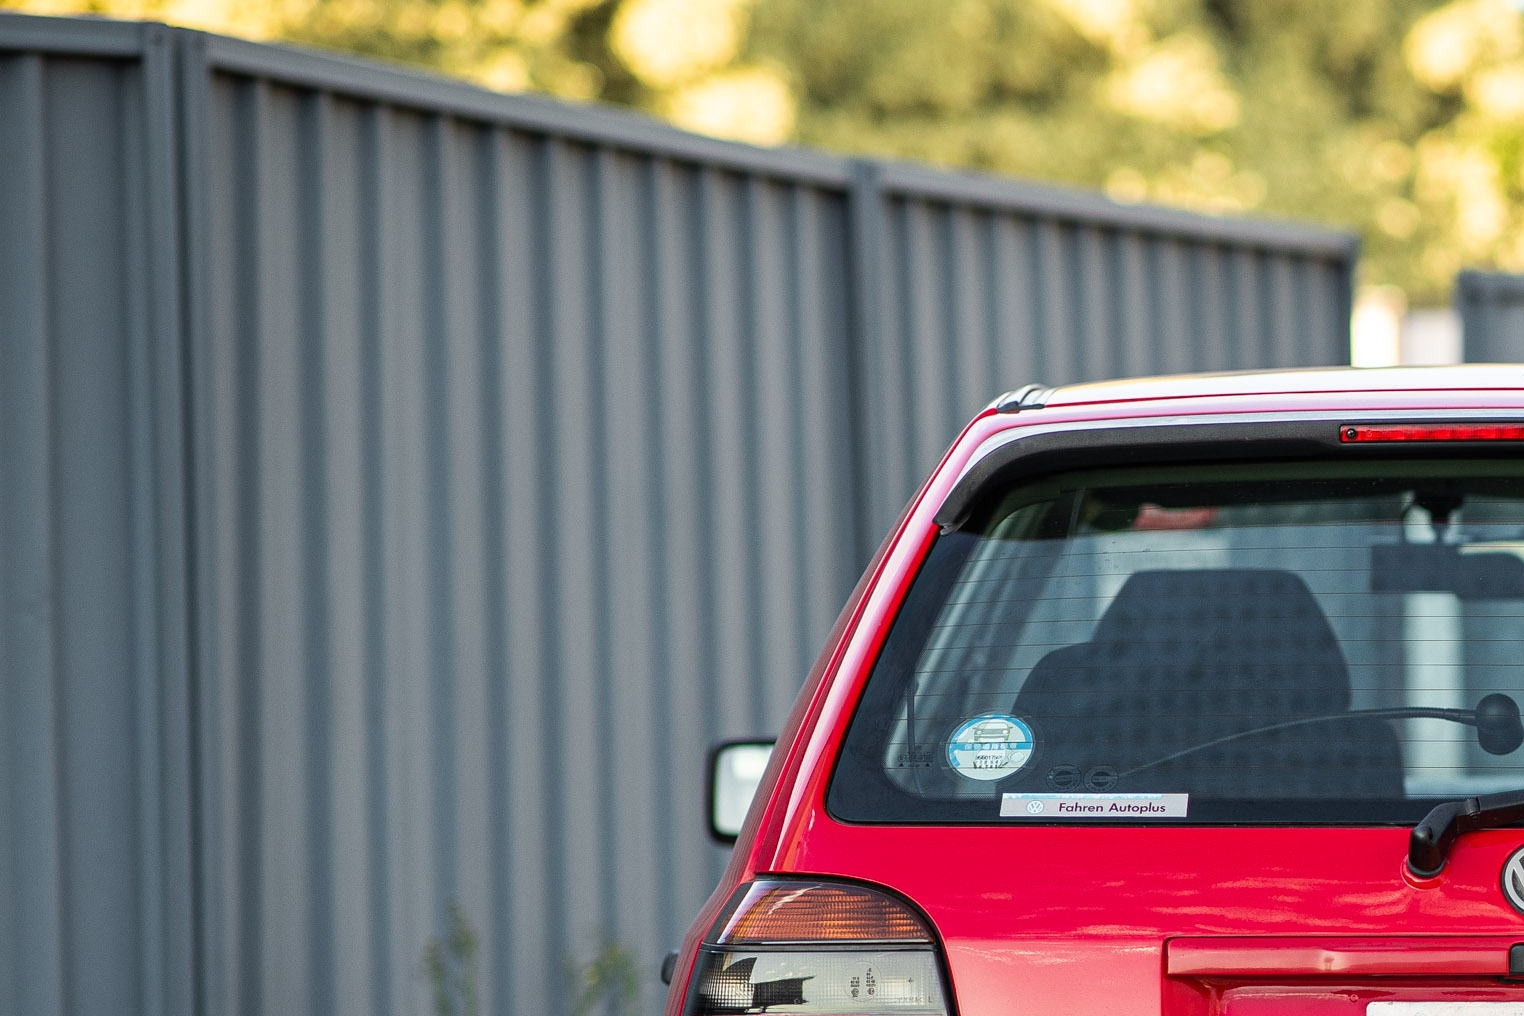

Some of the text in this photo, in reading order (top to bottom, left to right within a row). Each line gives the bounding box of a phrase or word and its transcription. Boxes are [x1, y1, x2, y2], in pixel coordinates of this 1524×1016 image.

[1026, 800, 1045, 815] VW
[1058, 802, 1166, 815] Fahren Autoplus
